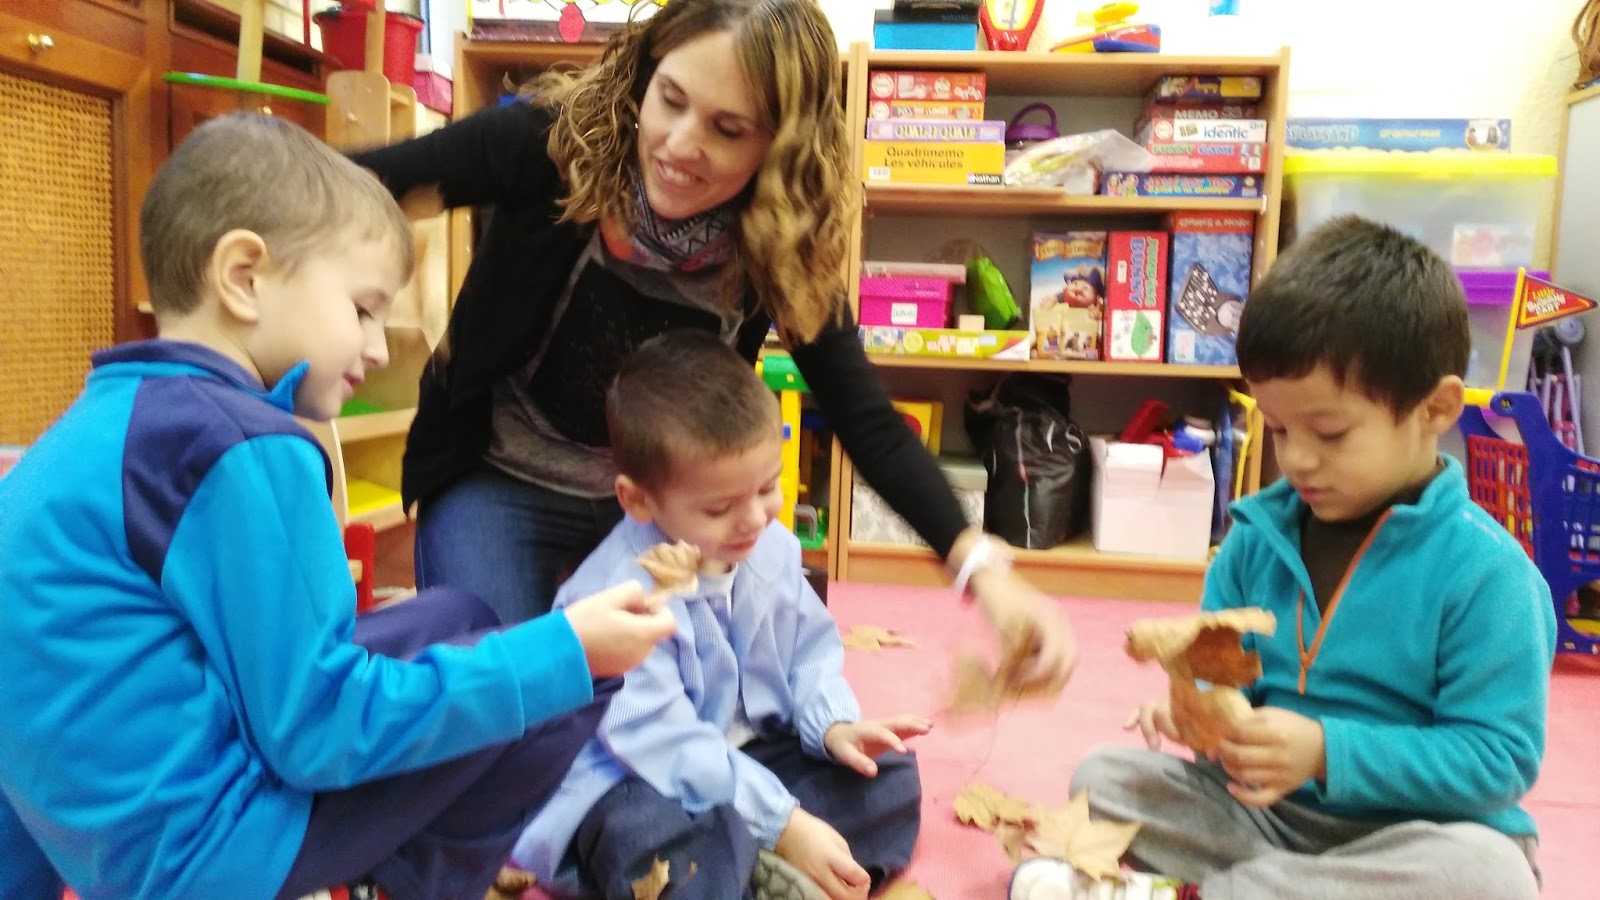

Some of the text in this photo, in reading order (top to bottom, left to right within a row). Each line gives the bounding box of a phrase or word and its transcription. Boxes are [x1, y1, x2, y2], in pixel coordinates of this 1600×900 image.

[1174, 109, 1218, 120] MEMO
[1203, 125, 1248, 139] identic
[886, 146, 964, 158] Quadrimemo
[1198, 144, 1233, 155] GAME
[884, 157, 963, 169] Les véhicules
[973, 174, 1000, 184] Nathan
[1128, 236, 1146, 308] BUNNY
